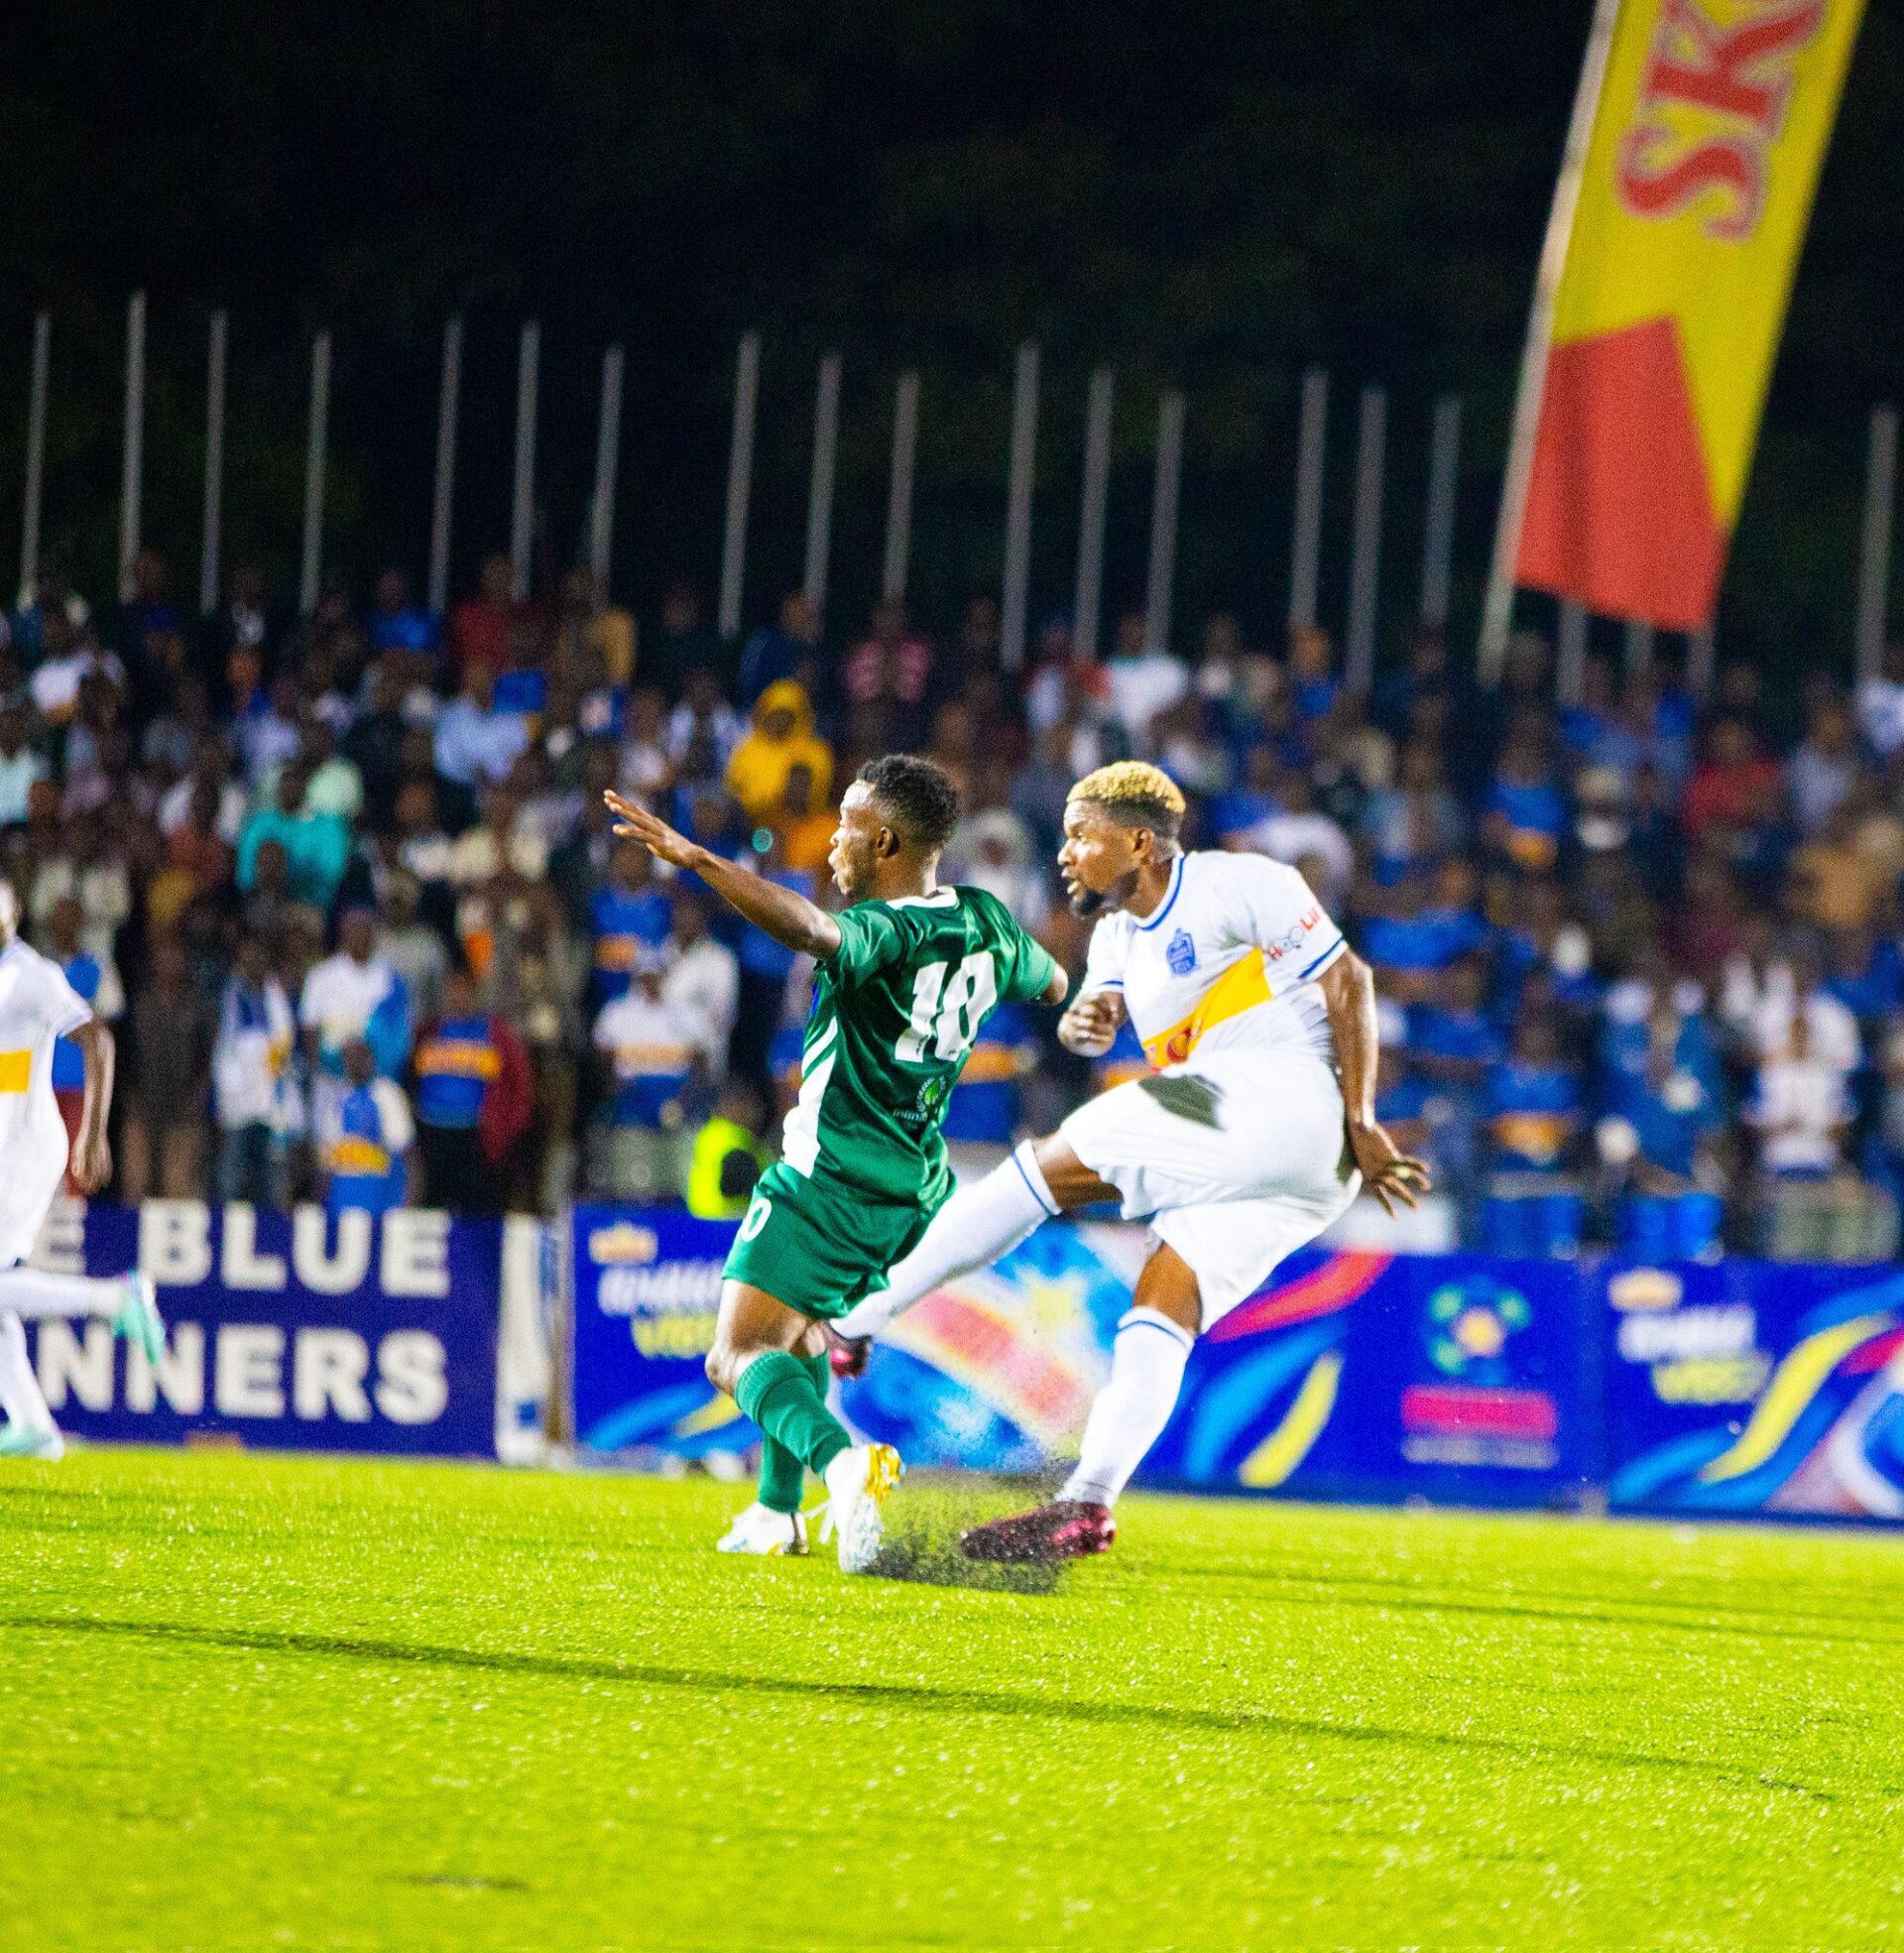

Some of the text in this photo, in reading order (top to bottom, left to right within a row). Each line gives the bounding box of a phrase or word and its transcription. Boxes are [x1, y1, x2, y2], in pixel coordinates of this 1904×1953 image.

[894, 950, 998, 1063] 10
[137, 1197, 453, 1298] BLUE
[36, 1315, 450, 1425] NNERS
